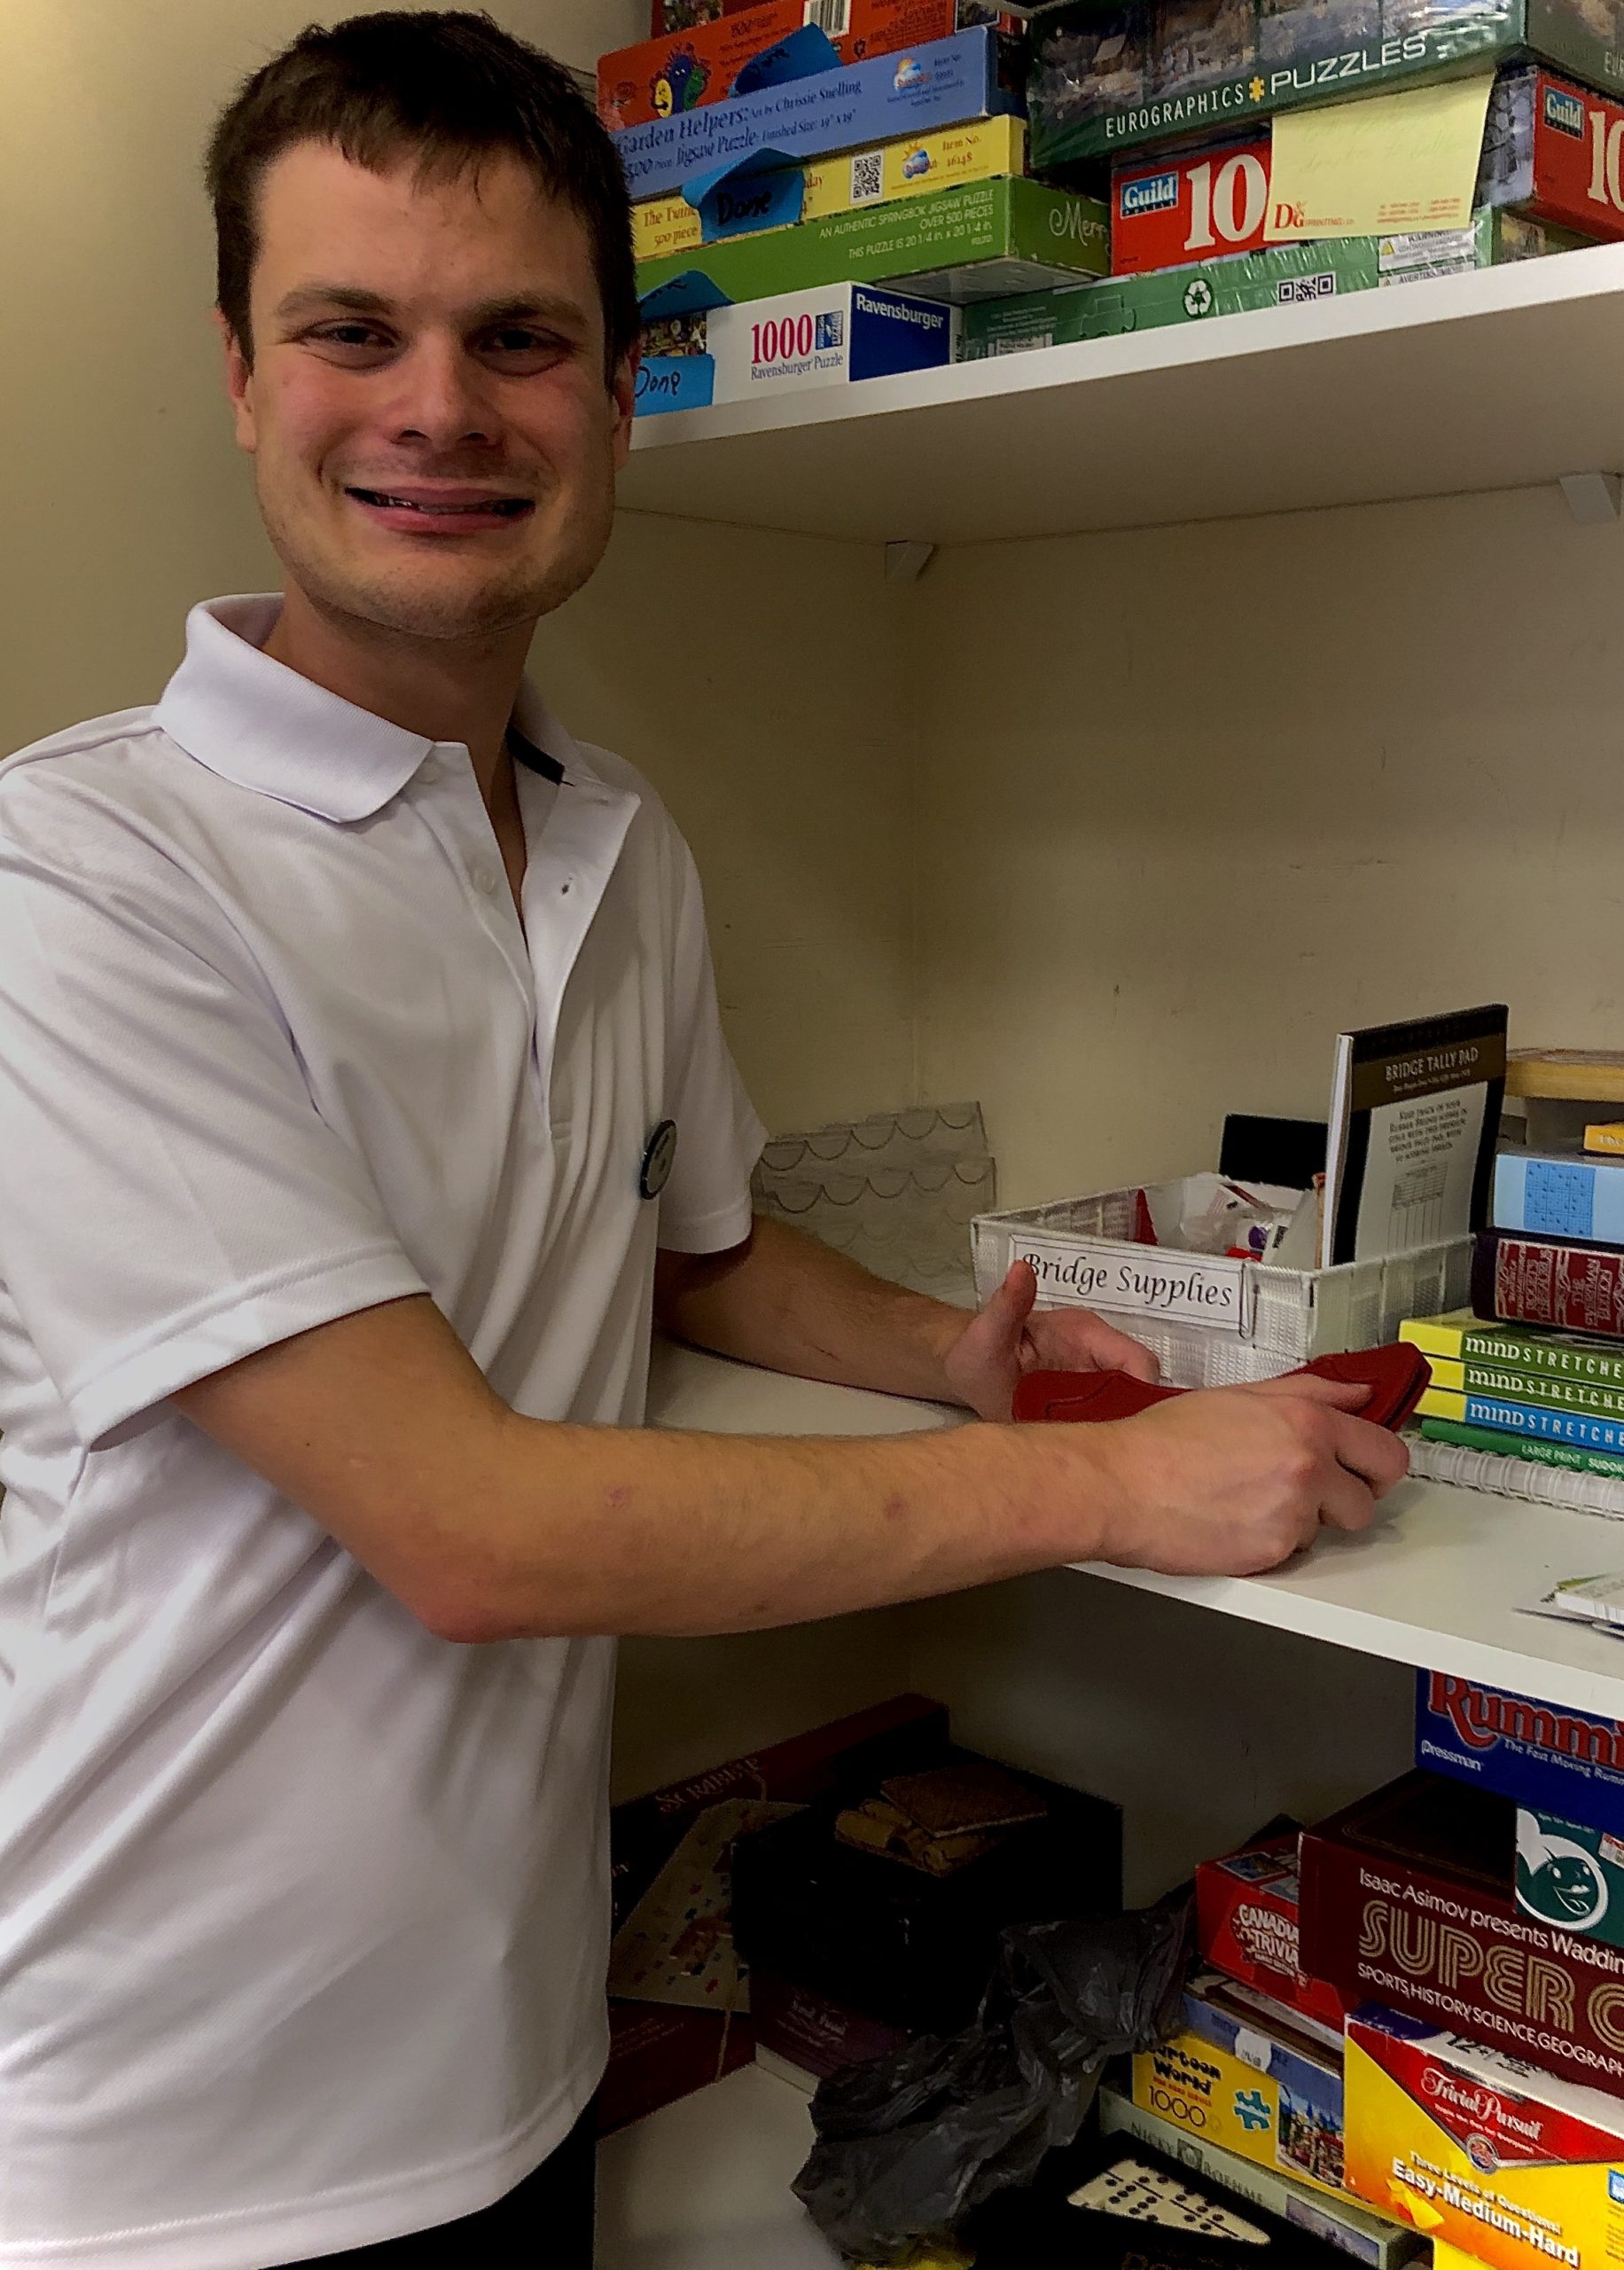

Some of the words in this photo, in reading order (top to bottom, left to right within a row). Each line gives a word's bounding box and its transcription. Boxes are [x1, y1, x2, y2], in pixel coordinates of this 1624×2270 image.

[1271, 35, 1427, 96] PUZZLES
[1105, 82, 1245, 139] EUROGRAPHICS
[1545, 93, 1582, 129] Guild
[616, 125, 675, 158] Garden
[942, 136, 964, 152] Item
[716, 191, 774, 227] Done
[1124, 176, 1175, 209] Guild
[1184, 153, 1268, 250] 10
[644, 210, 663, 228] The
[819, 227, 833, 239] AN
[833, 217, 877, 238] AUTHENTIC
[928, 197, 962, 215] JIGSAW
[963, 189, 995, 207] PUZZLE
[919, 215, 944, 231] OVER
[964, 204, 995, 221] PIECES
[1049, 200, 1108, 247] Merr
[673, 227, 699, 246] piece
[848, 247, 865, 260] THIS
[866, 239, 894, 256] PUZZLE
[856, 293, 944, 331] Ravensburger
[751, 314, 813, 364] 1000
[635, 365, 681, 398] Done
[751, 359, 812, 381] Ravensburger
[814, 353, 844, 371] Puzzle
[1386, 1058, 1425, 1082] BRIDGE
[1426, 1051, 1457, 1072] TALLY
[1459, 1046, 1479, 1064] PAD
[1023, 1253, 1108, 1295] Bridge
[1116, 1265, 1233, 1308] Supplies
[1521, 1444, 1552, 1460] LARGE
[1553, 1449, 1581, 1465] PRINT
[1422, 1739, 1482, 1772] pressman
[1504, 1739, 1525, 1754] The
[1526, 1746, 1549, 1762] Fast
[1551, 1754, 1592, 1778] Moving
[1360, 1867, 1401, 1898] Isaac
[1402, 1884, 1468, 1921] Asimov
[1471, 1909, 1549, 1950] presents
[1250, 1928, 1299, 1969] TRIVIA
[1359, 1899, 1575, 2034] SUPER
[1153, 2057, 1212, 2095] World
[1150, 2085, 1206, 2127] 1000
[1421, 2067, 1481, 2114] Trivial
[1473, 2088, 1543, 2141] Pursuit
[1392, 2156, 1580, 2268] Easy-Medium-Hard
